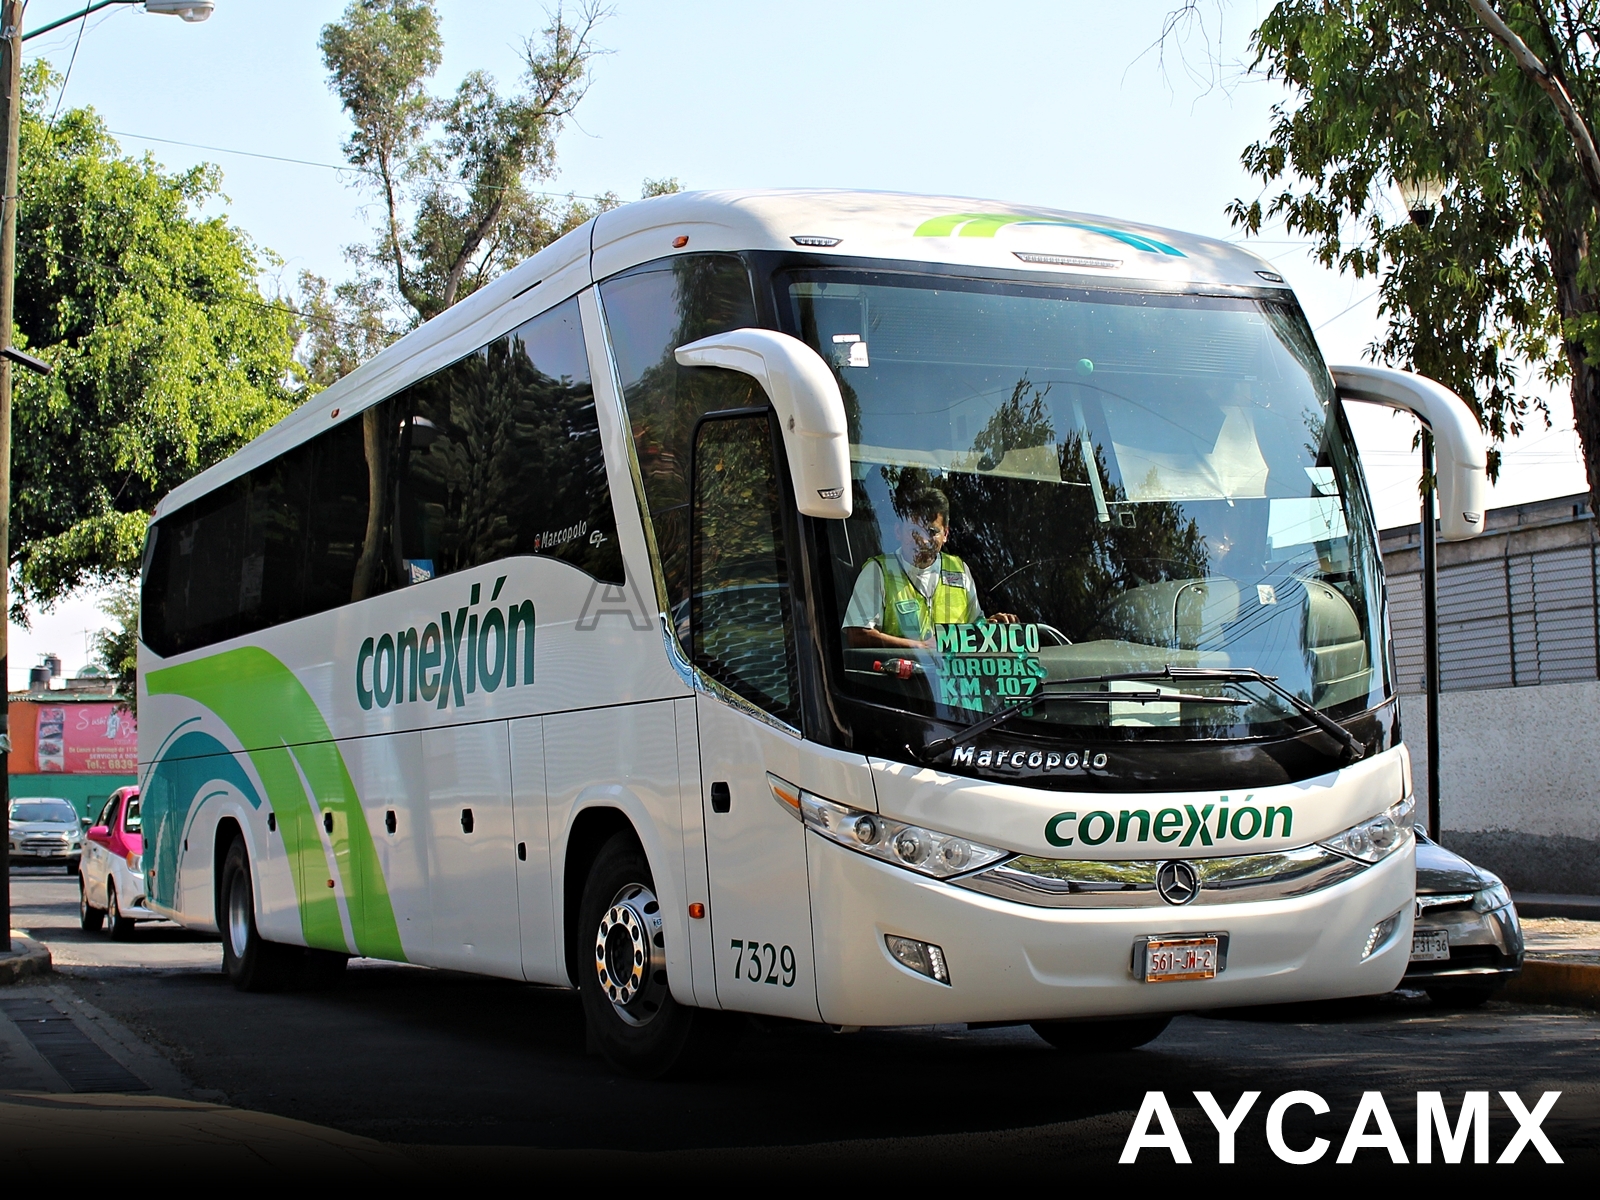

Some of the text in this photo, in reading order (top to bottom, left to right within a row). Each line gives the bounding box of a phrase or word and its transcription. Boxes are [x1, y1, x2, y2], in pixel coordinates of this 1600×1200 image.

[541, 520, 587, 549] Marcopolo
[935, 623, 1040, 653] MEXICO
[935, 658, 1041, 676] JOROBAS
[76, 708, 107, 731] Sushi
[85, 759, 106, 769] Tel.:
[951, 745, 1108, 772] Marcopolo
[730, 938, 797, 988] 7329
[1152, 949, 1212, 972] 561-JW-2
